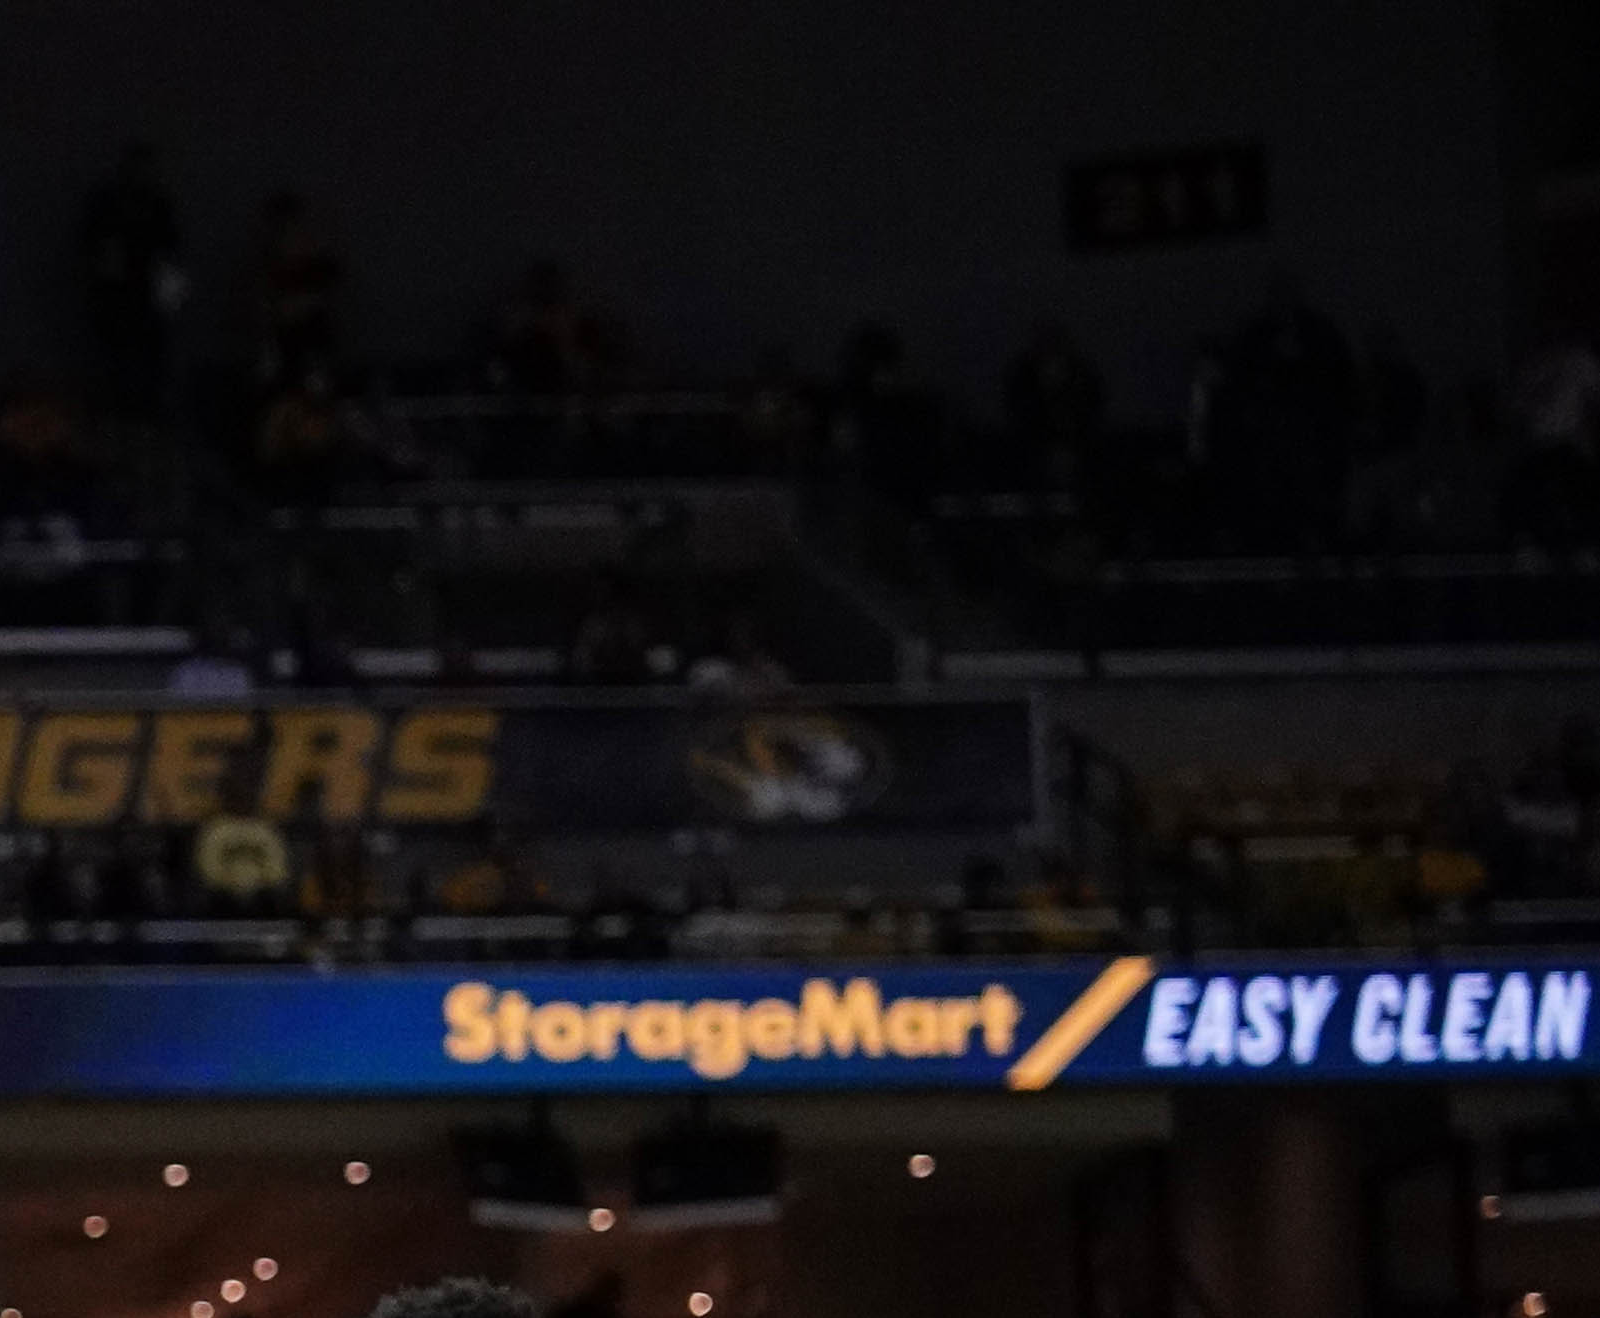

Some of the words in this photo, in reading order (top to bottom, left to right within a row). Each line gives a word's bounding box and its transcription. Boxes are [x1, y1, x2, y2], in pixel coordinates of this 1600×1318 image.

[441, 977, 1023, 1079] StorageMart
[1143, 970, 1339, 1070] EASY
[1352, 968, 1590, 1068] CLEAN
